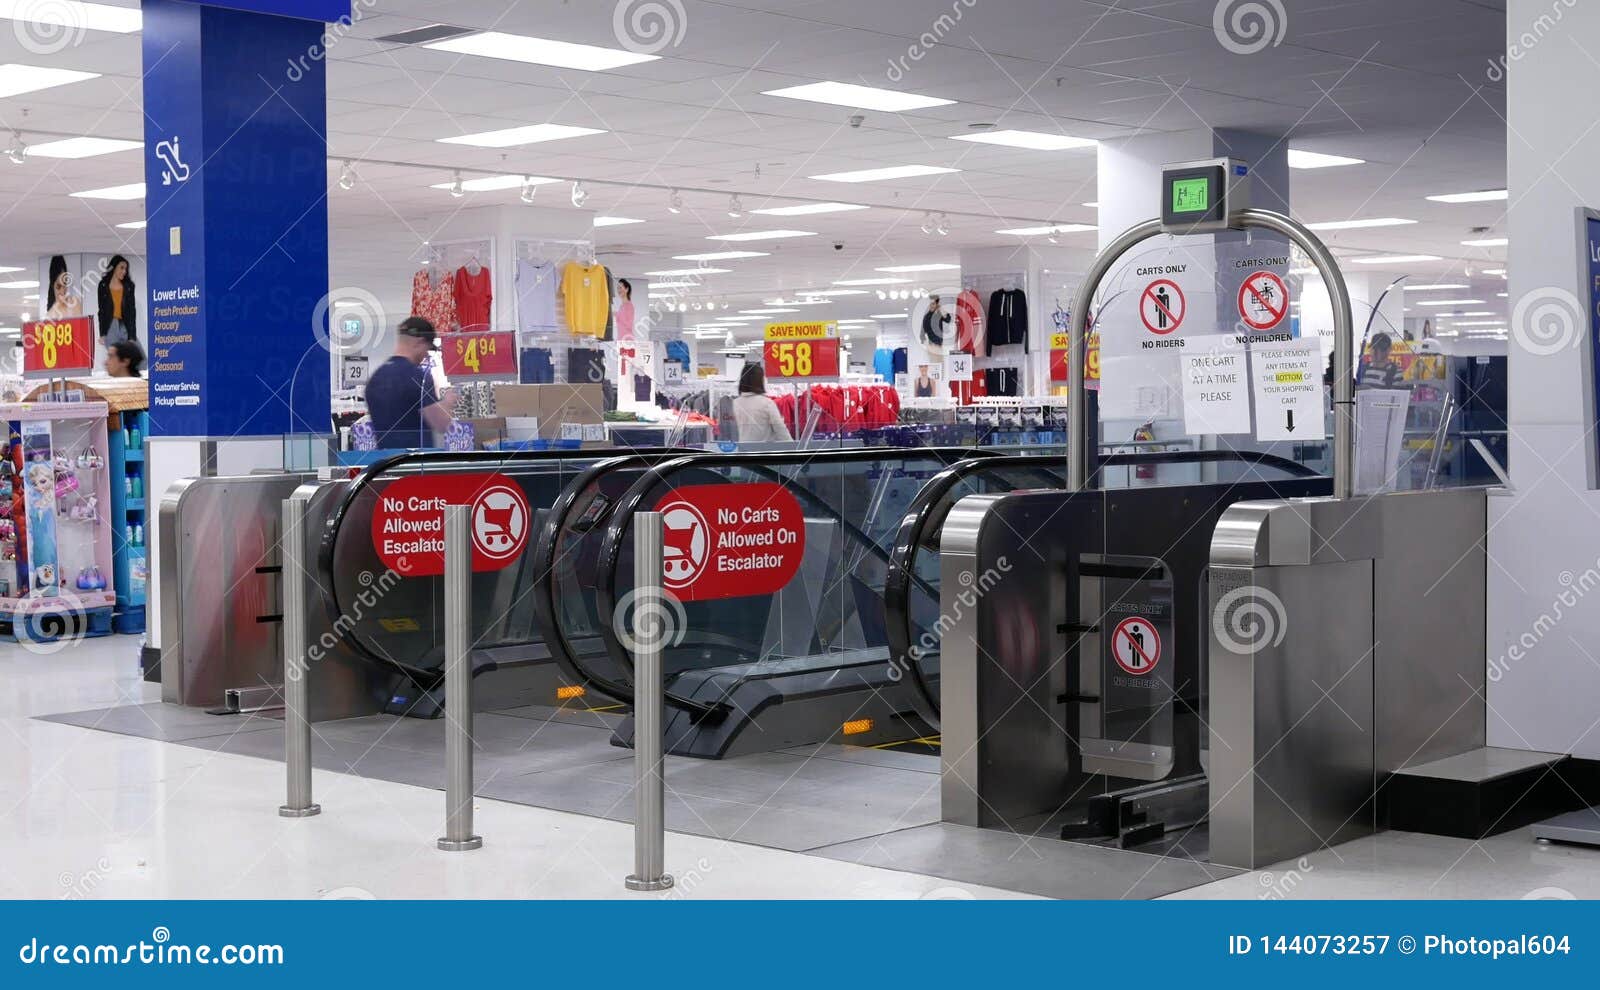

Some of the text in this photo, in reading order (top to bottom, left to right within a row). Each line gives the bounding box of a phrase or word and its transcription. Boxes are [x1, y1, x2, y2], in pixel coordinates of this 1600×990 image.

[1236, 257, 1288, 268] CARTS ONLY
[1137, 264, 1187, 276] CARTS ONLY
[153, 285, 199, 301] Lower Level:
[154, 305, 198, 317] Fresh Produce
[154, 321, 179, 332] Grocery
[770, 325, 794, 337] SAVE
[795, 324, 822, 336] NOW!
[155, 334, 192, 344] Housewares
[1142, 339, 1185, 349] NO RIDERS
[1236, 333, 1293, 344] NO CHILDREN
[155, 348, 169, 358] Pets
[1261, 350, 1311, 359] PLEASE REMOVE
[771, 342, 812, 377] $58
[1191, 356, 1236, 368] ONE CART
[155, 361, 184, 371] Seasonal
[1192, 374, 1237, 385] AT A TIME
[1275, 374, 1303, 382] BOTTOM
[155, 381, 200, 392] Customer Service
[1281, 385, 1314, 393] SHOPPING
[155, 396, 175, 407] Pickup
[1200, 392, 1232, 402] PLEASE
[383, 496, 447, 512] No Carts
[717, 507, 780, 525] No Carts
[383, 517, 441, 533] Allowed
[717, 528, 797, 548] Allowed On
[383, 539, 445, 554] Escalato
[717, 554, 784, 572] Escalator
